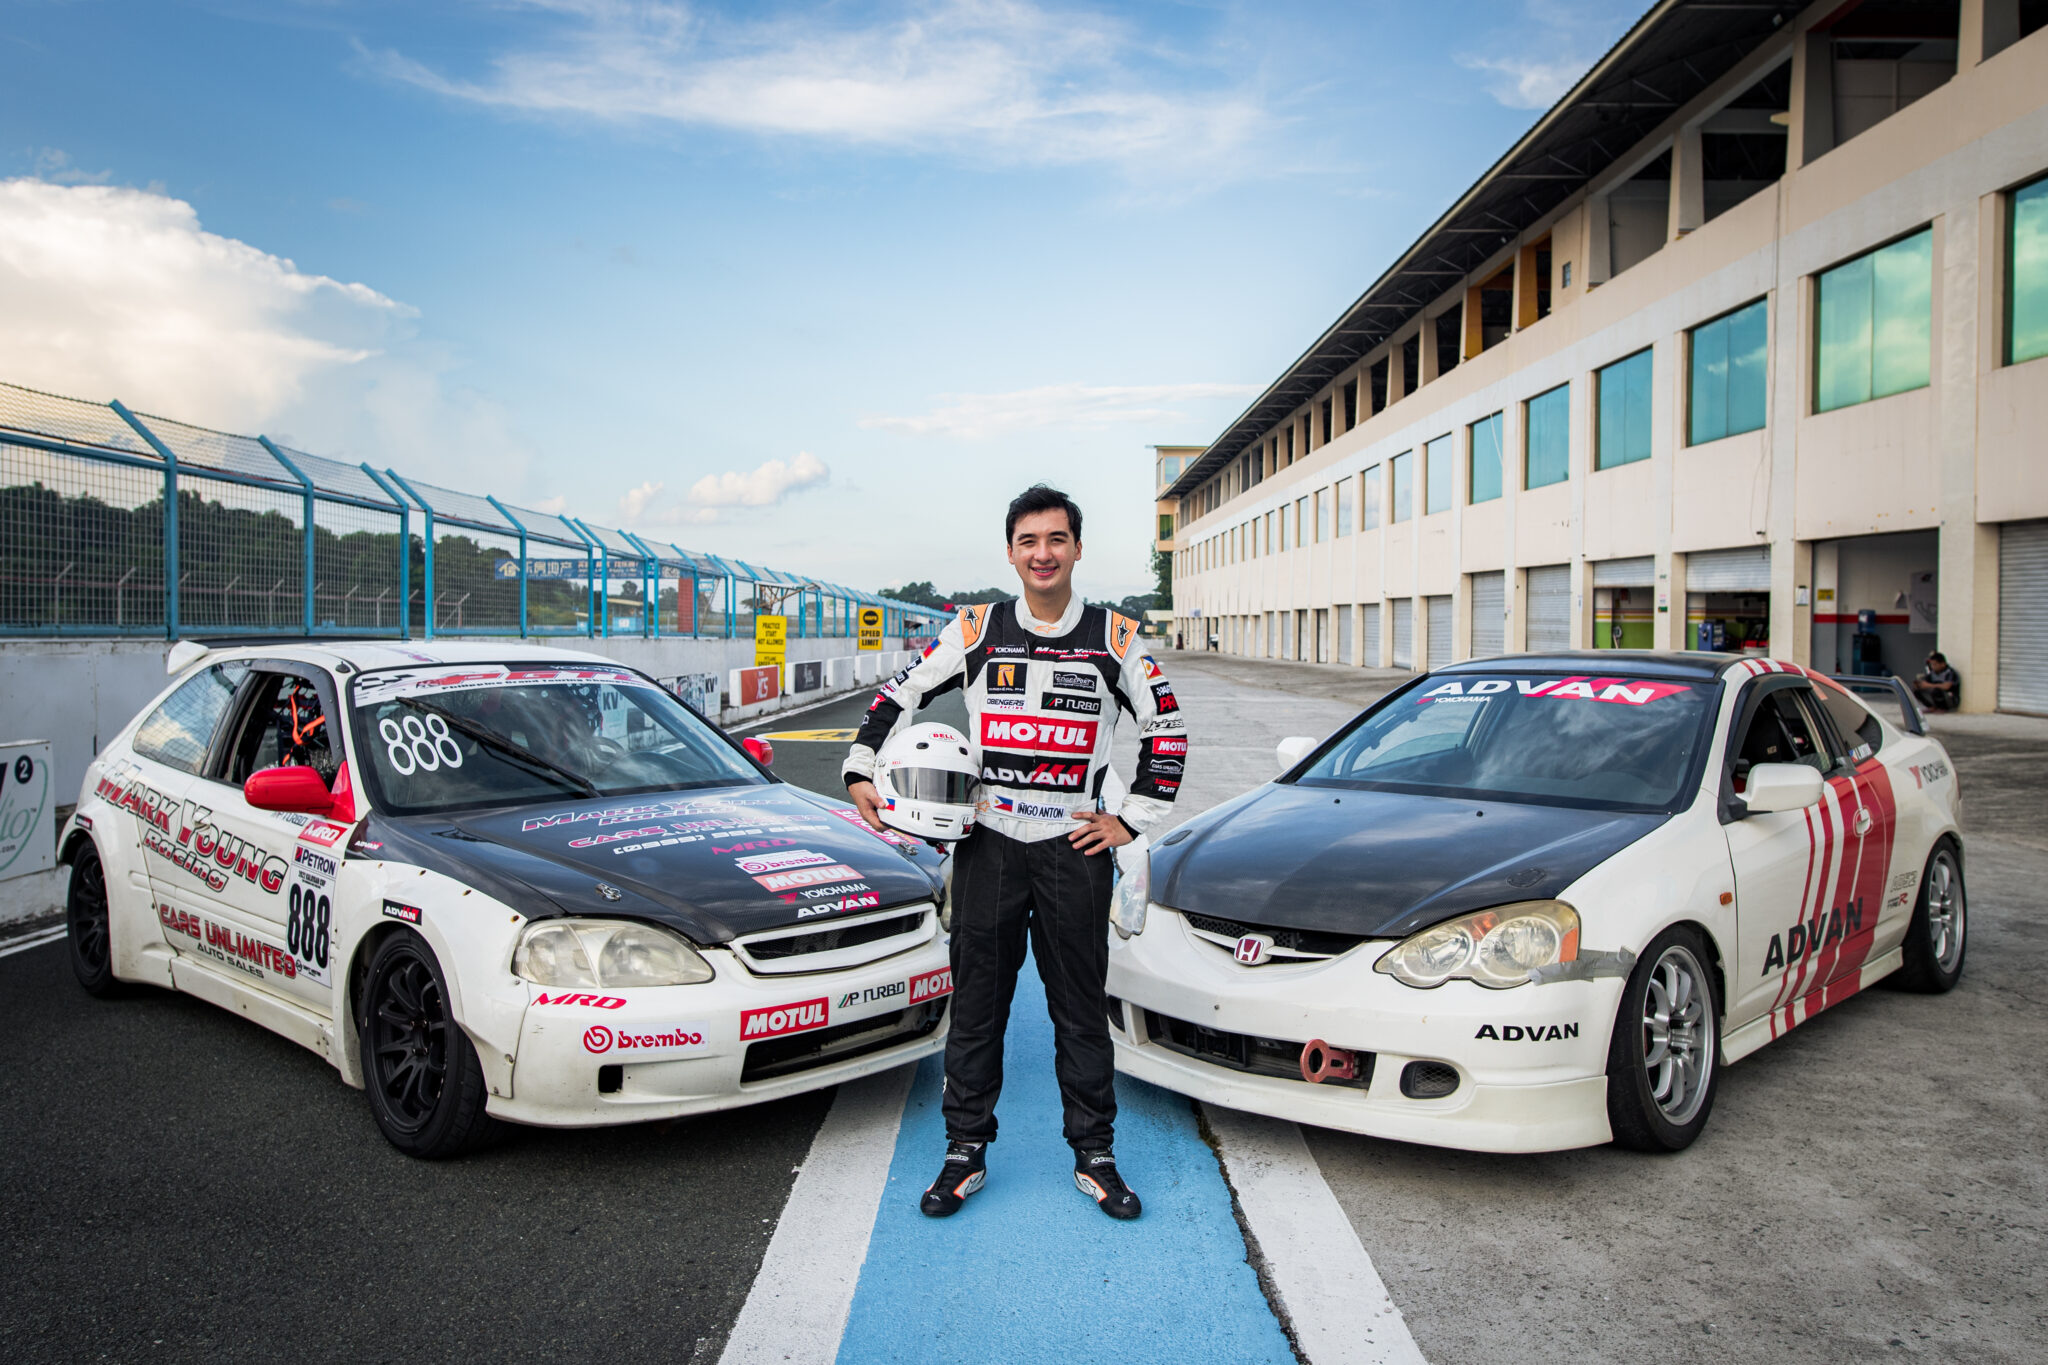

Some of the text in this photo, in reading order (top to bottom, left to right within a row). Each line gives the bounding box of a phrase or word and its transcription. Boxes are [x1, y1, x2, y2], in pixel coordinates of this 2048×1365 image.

[995, 646, 1026, 655] YOKOHAMA
[1422, 679, 1656, 704] ADVAN
[1434, 696, 1491, 704] YOKOHAMA
[1065, 699, 1100, 712] TURBO
[987, 720, 1089, 747] MOTUL
[379, 713, 464, 776] 888
[20, 761, 28, 779] 2
[981, 766, 1079, 786] ADVAN
[521, 804, 660, 832] MARK
[1017, 801, 1065, 819] IÑIGO ANTON
[94, 758, 290, 895] MARK YOUNG
[304, 823, 340, 842] MRD
[568, 825, 667, 849] CARS
[354, 840, 380, 850] ADVAN
[711, 837, 798, 855] MRD
[142, 828, 229, 893] Racing
[301, 848, 336, 877] PETRON
[766, 855, 828, 868] brembo
[765, 867, 857, 889] MOTUL
[800, 882, 871, 899] YOKOHAMA
[384, 905, 416, 921] ADVAN
[797, 896, 879, 919] ADVAN
[287, 883, 331, 969] 888
[1761, 896, 1863, 977] ADVAN
[159, 903, 297, 979] CARS UNLIMITED
[197, 943, 264, 979] AUTO SALES
[531, 992, 627, 1010] MRD
[744, 1002, 826, 1036] MOTUL
[618, 1028, 703, 1049] brembo
[1474, 1022, 1579, 1041] ADVAN
